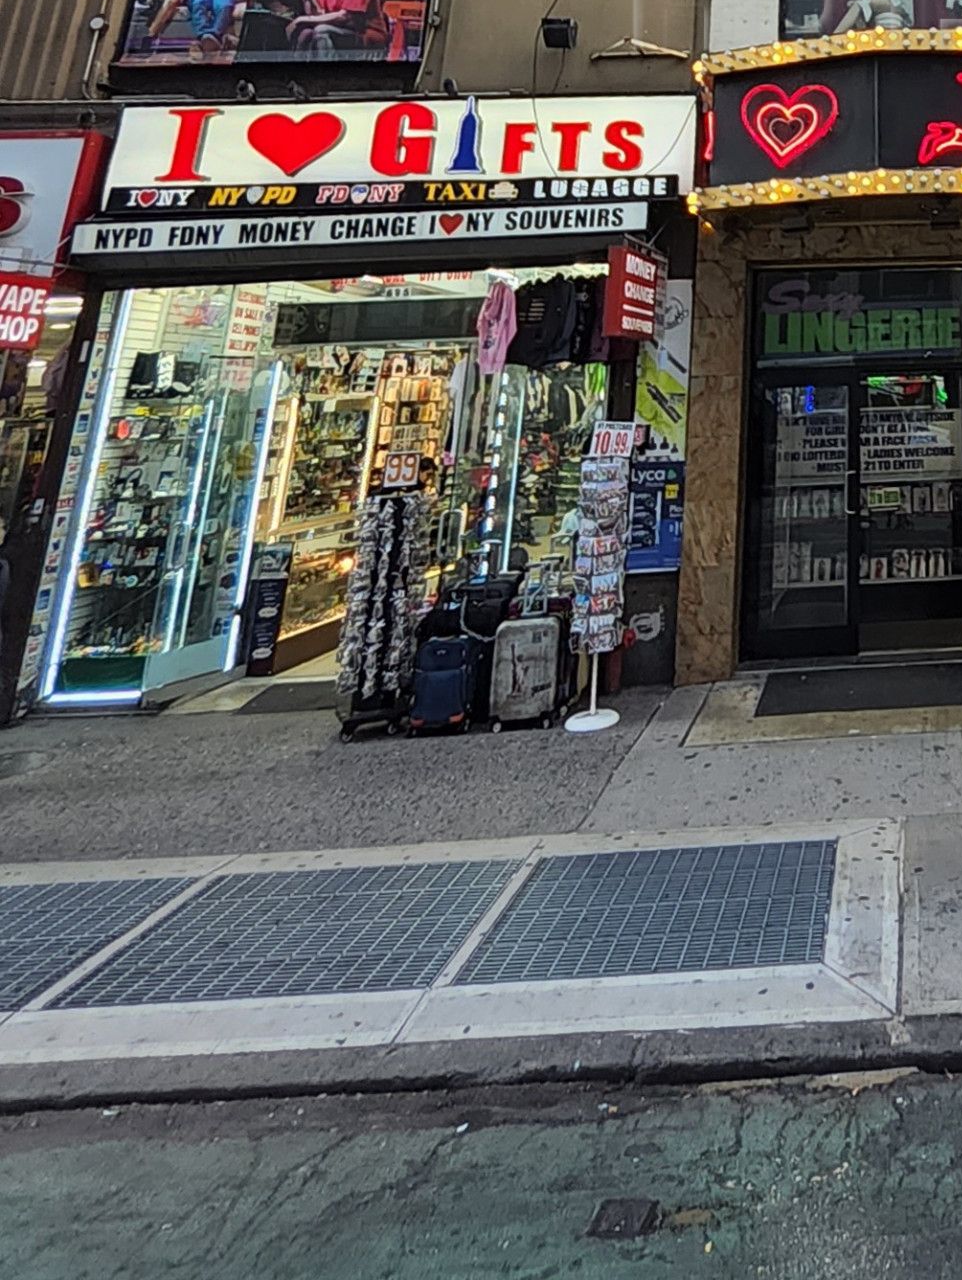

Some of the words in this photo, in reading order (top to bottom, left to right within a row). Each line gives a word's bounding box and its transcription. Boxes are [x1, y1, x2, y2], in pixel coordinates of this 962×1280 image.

[154, 108, 224, 182] I
[424, 182, 487, 201] TAXI
[94, 227, 153, 250] NYPD
[168, 224, 224, 247] FDNY
[238, 221, 316, 244] MONEY
[330, 215, 417, 240] CHANGE
[505, 207, 625, 231] SOUVENIRS
[625, 253, 656, 281] MONEY
[624, 280, 655, 305] CHANGE
[764, 307, 962, 354] LINGERIE
[893, 459, 925, 470] ENTER
[905, 446, 956, 458] WELCOME
[631, 468, 666, 485] Lyca
